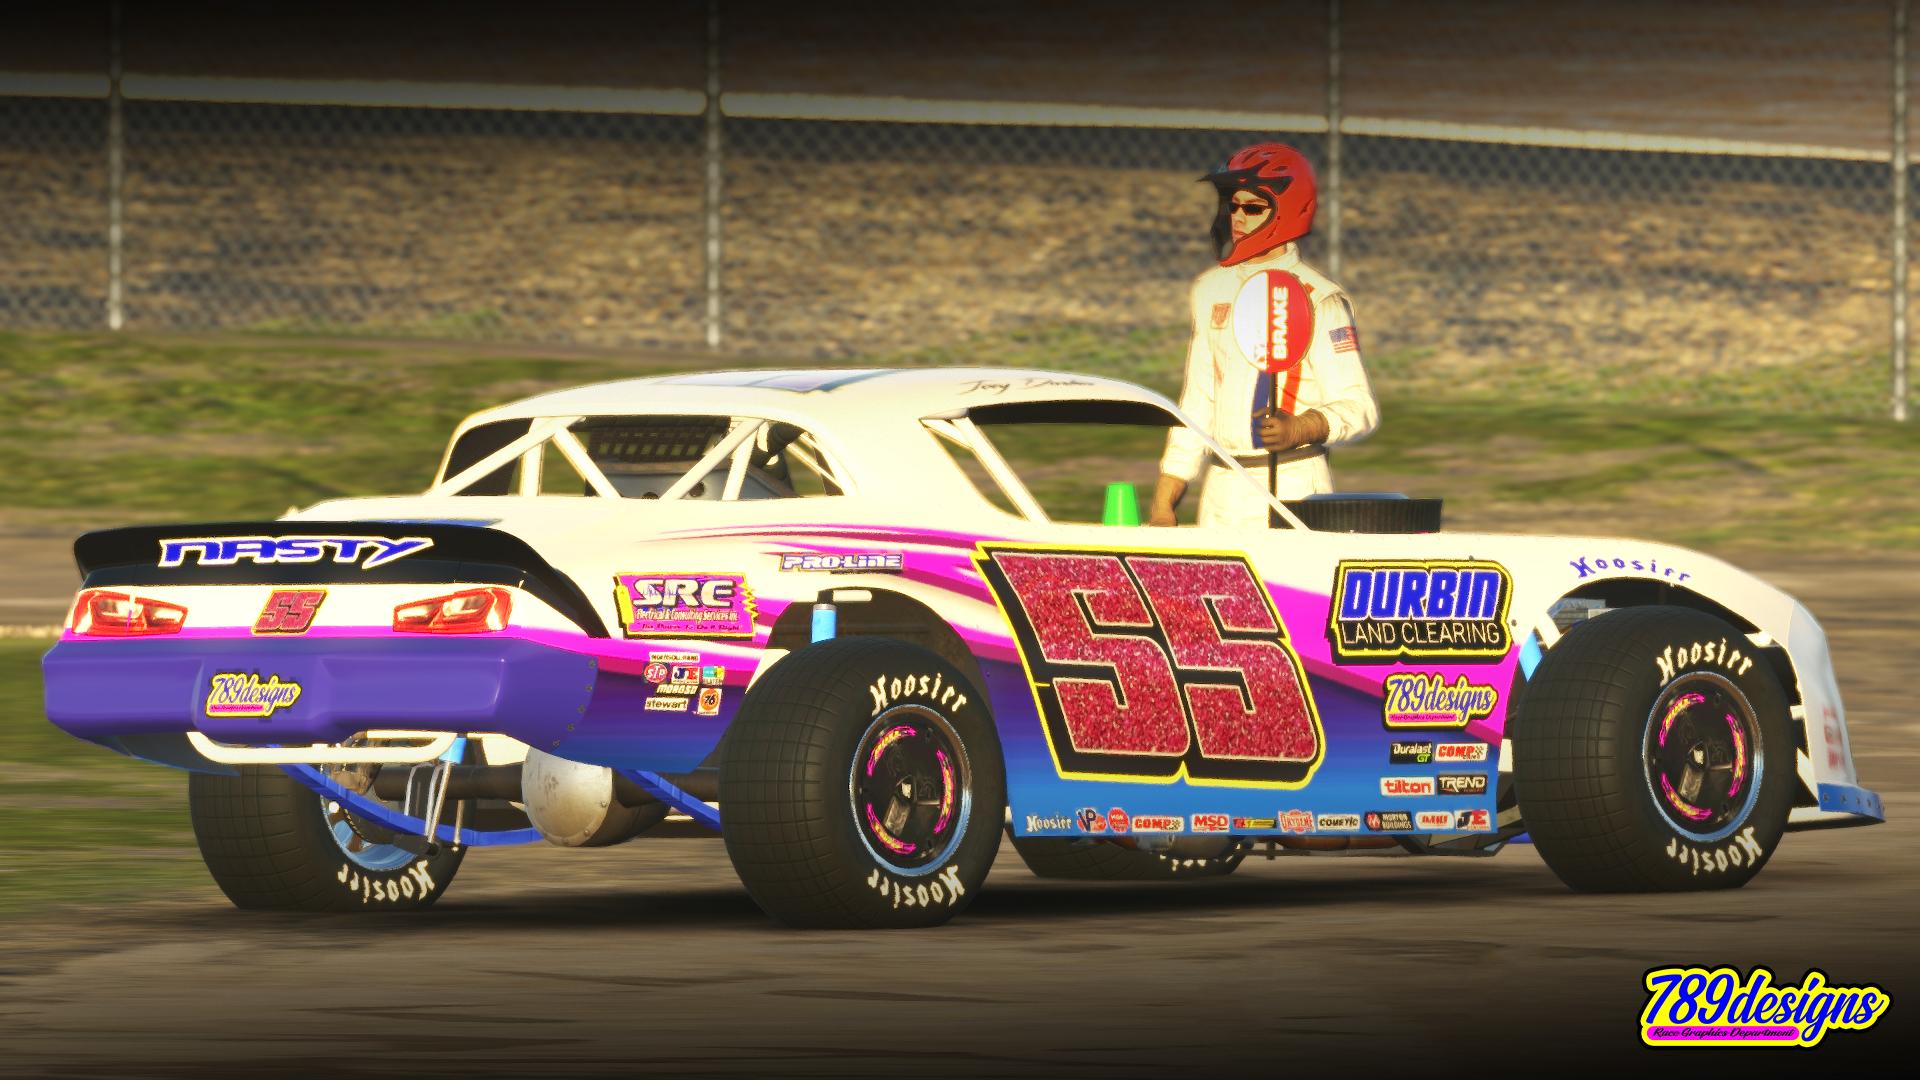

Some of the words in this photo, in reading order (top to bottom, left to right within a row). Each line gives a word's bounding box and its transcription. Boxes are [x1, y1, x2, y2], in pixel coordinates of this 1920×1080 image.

[1272, 286, 1289, 360] BRAKE
[157, 536, 434, 569] NASTY
[1570, 556, 1691, 582] Hoosier
[1339, 568, 1502, 620] DURBIN
[255, 590, 326, 632] 55
[637, 608, 664, 620] Electrical
[671, 609, 703, 624] Consulting
[703, 609, 729, 621] Services
[1342, 622, 1396, 643] LAND
[1401, 622, 1500, 644] CLEARING
[992, 552, 1317, 762] 55
[1656, 638, 1752, 687] Hoosier
[647, 665, 666, 679] STP
[674, 667, 699, 680] JE
[209, 677, 296, 712] 789designs
[647, 700, 688, 708] stewart
[704, 694, 715, 706] 76
[870, 673, 967, 716] Hoosier
[1387, 678, 1492, 722] 789designs
[1394, 743, 1432, 754] Duralast
[1417, 754, 1431, 763] GT
[1439, 746, 1474, 757] COMP
[1385, 779, 1432, 793] tilton
[1439, 777, 1486, 792] TREND
[1026, 814, 1072, 832] Hoosier
[1134, 818, 1173, 829] COMP
[1194, 815, 1229, 827] MSD
[1457, 810, 1488, 829] JE
[1666, 826, 1763, 875] Hoosier
[338, 859, 435, 903] Hoosier
[868, 865, 965, 909] Hoosier
